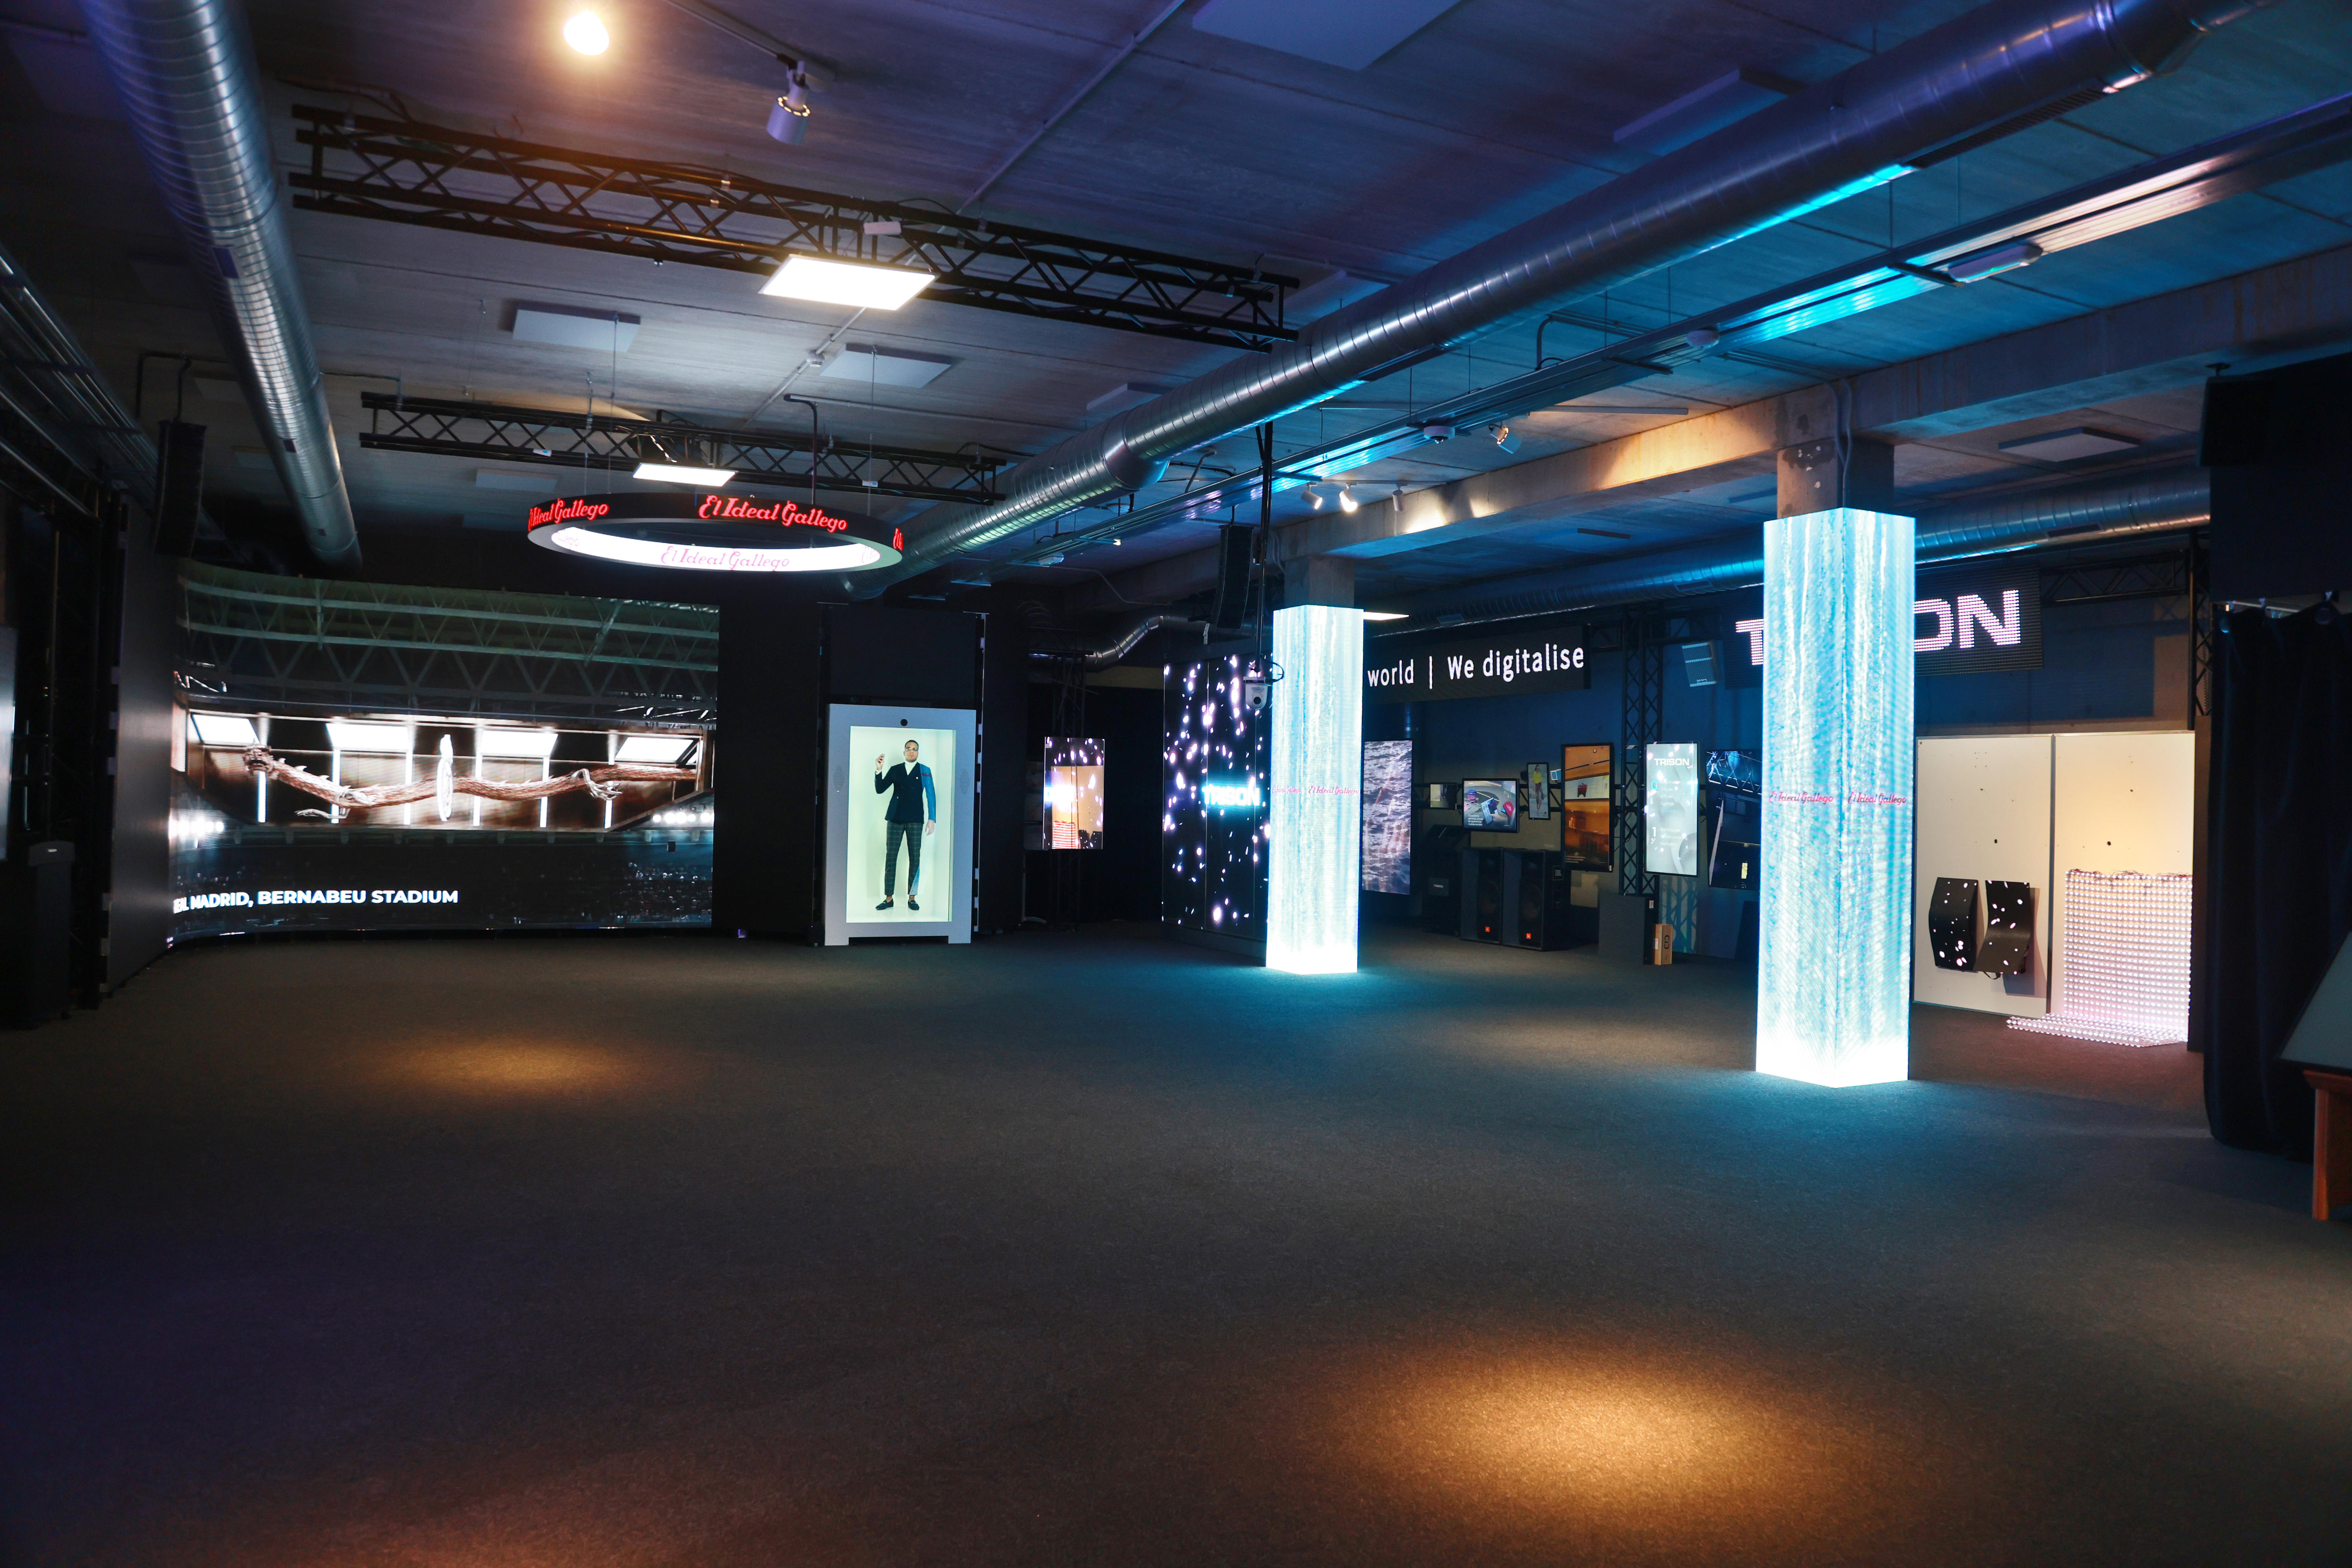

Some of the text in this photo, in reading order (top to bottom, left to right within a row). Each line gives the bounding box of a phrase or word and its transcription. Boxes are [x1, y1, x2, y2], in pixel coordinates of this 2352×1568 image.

[554, 498, 610, 524] Gallego
[699, 495, 848, 533] El Ideal Gallego
[661, 546, 789, 572] El Ideal Gallego
[1367, 659, 1414, 687] world
[1447, 655, 1474, 680] We
[1483, 643, 1584, 682] digitalise
[1202, 786, 1260, 806] TRISON
[190, 892, 254, 909] MADRID,
[258, 890, 366, 905] BERNABEU
[372, 890, 458, 904] STADIUM
